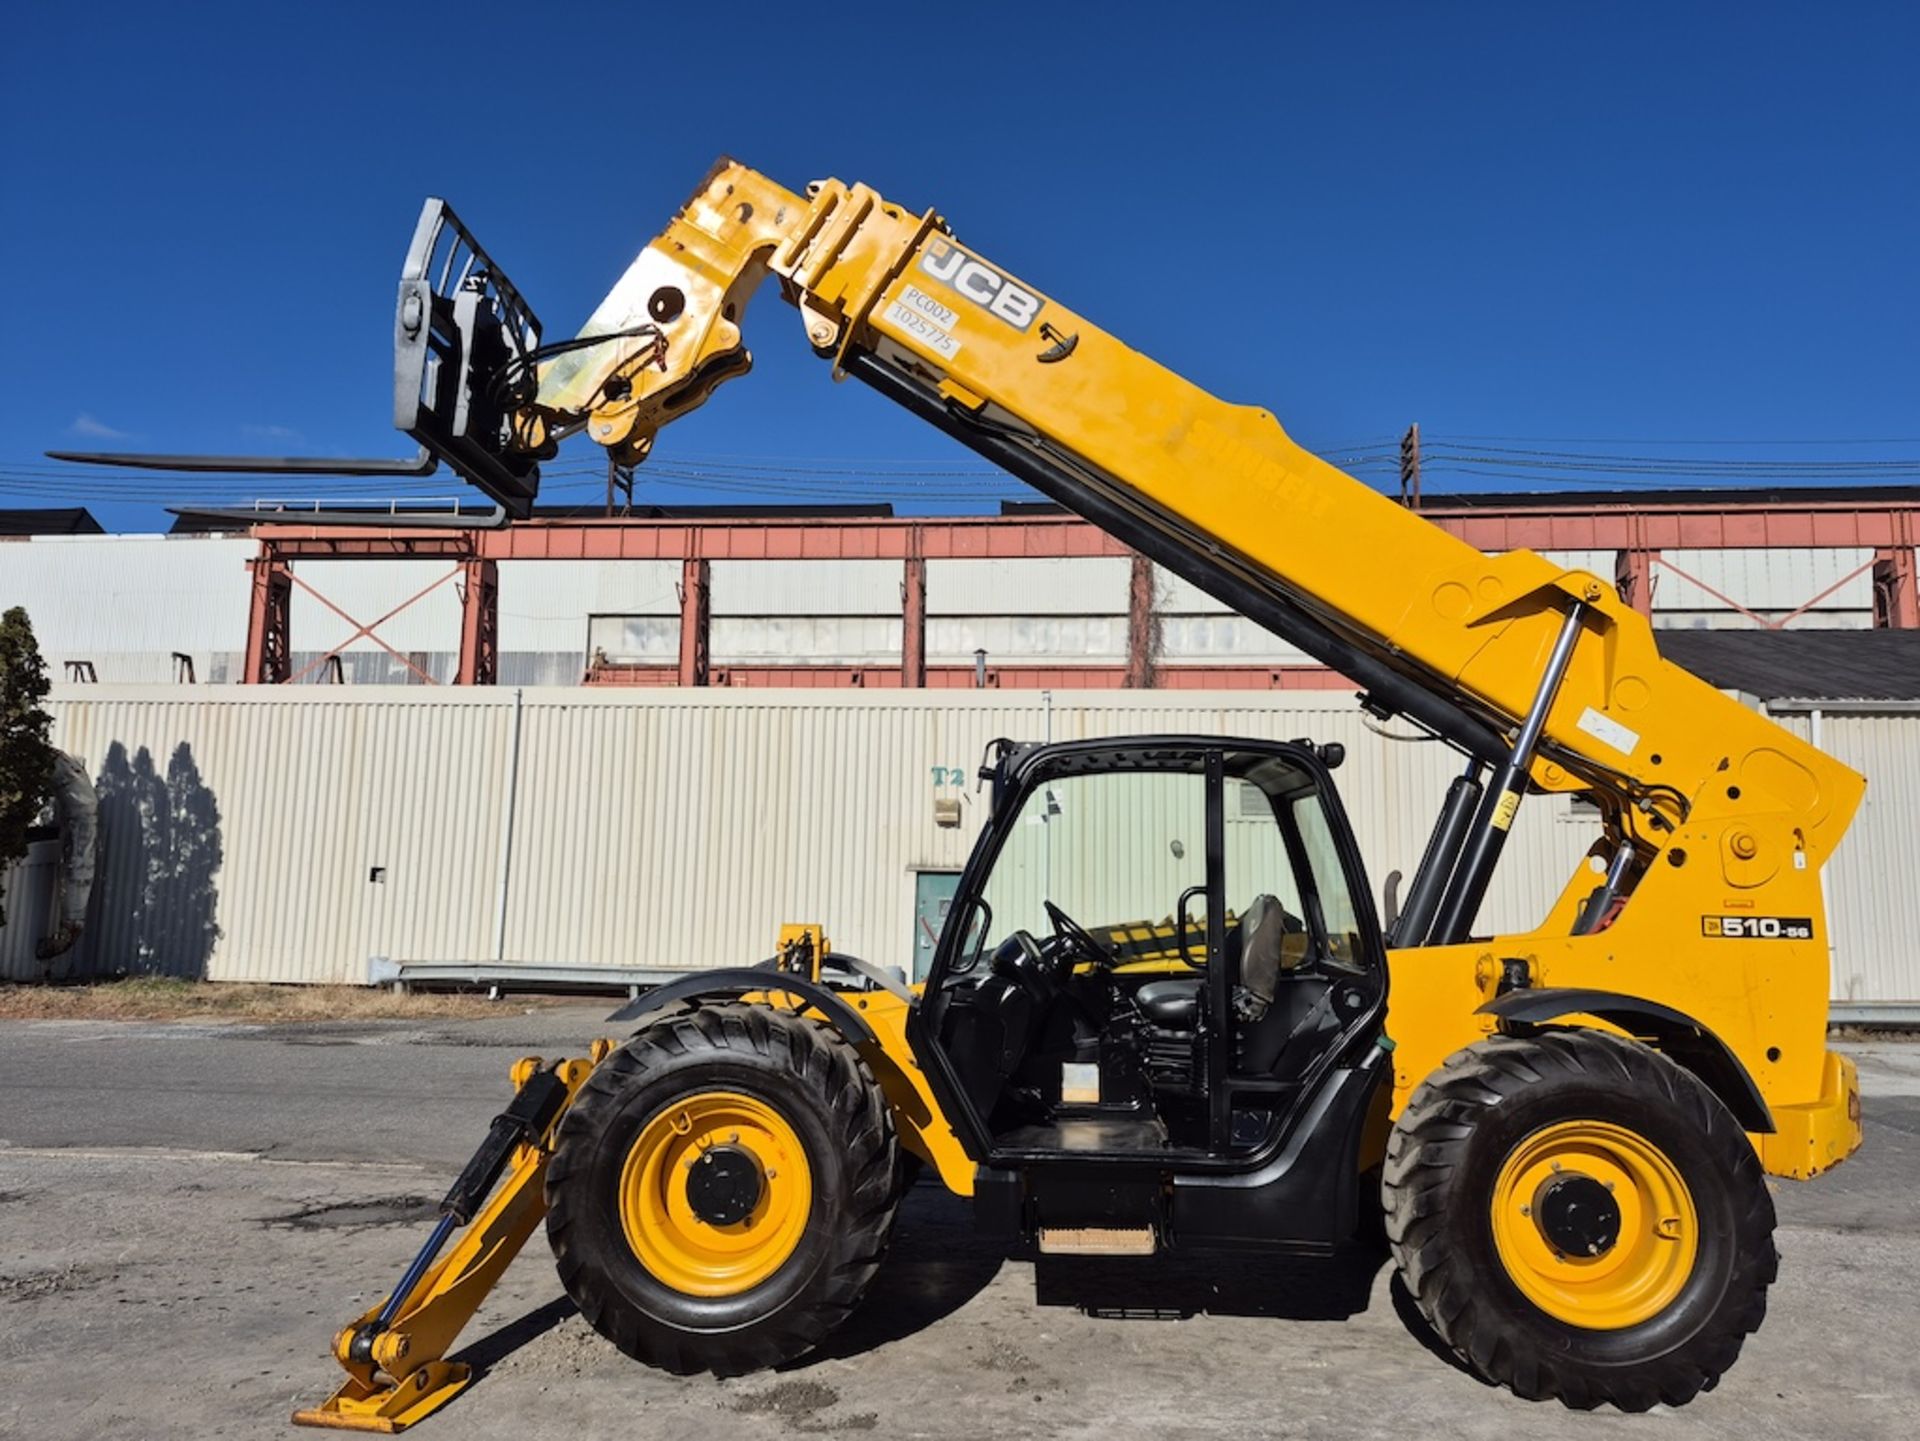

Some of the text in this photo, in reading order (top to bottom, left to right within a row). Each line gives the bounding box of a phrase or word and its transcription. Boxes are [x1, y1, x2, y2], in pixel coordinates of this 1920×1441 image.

[906, 288, 953, 324] PC002
[922, 250, 1040, 329] JCB
[893, 306, 954, 351] 1025775
[931, 766, 965, 787] T2
[1722, 917, 1810, 938] 510-56
